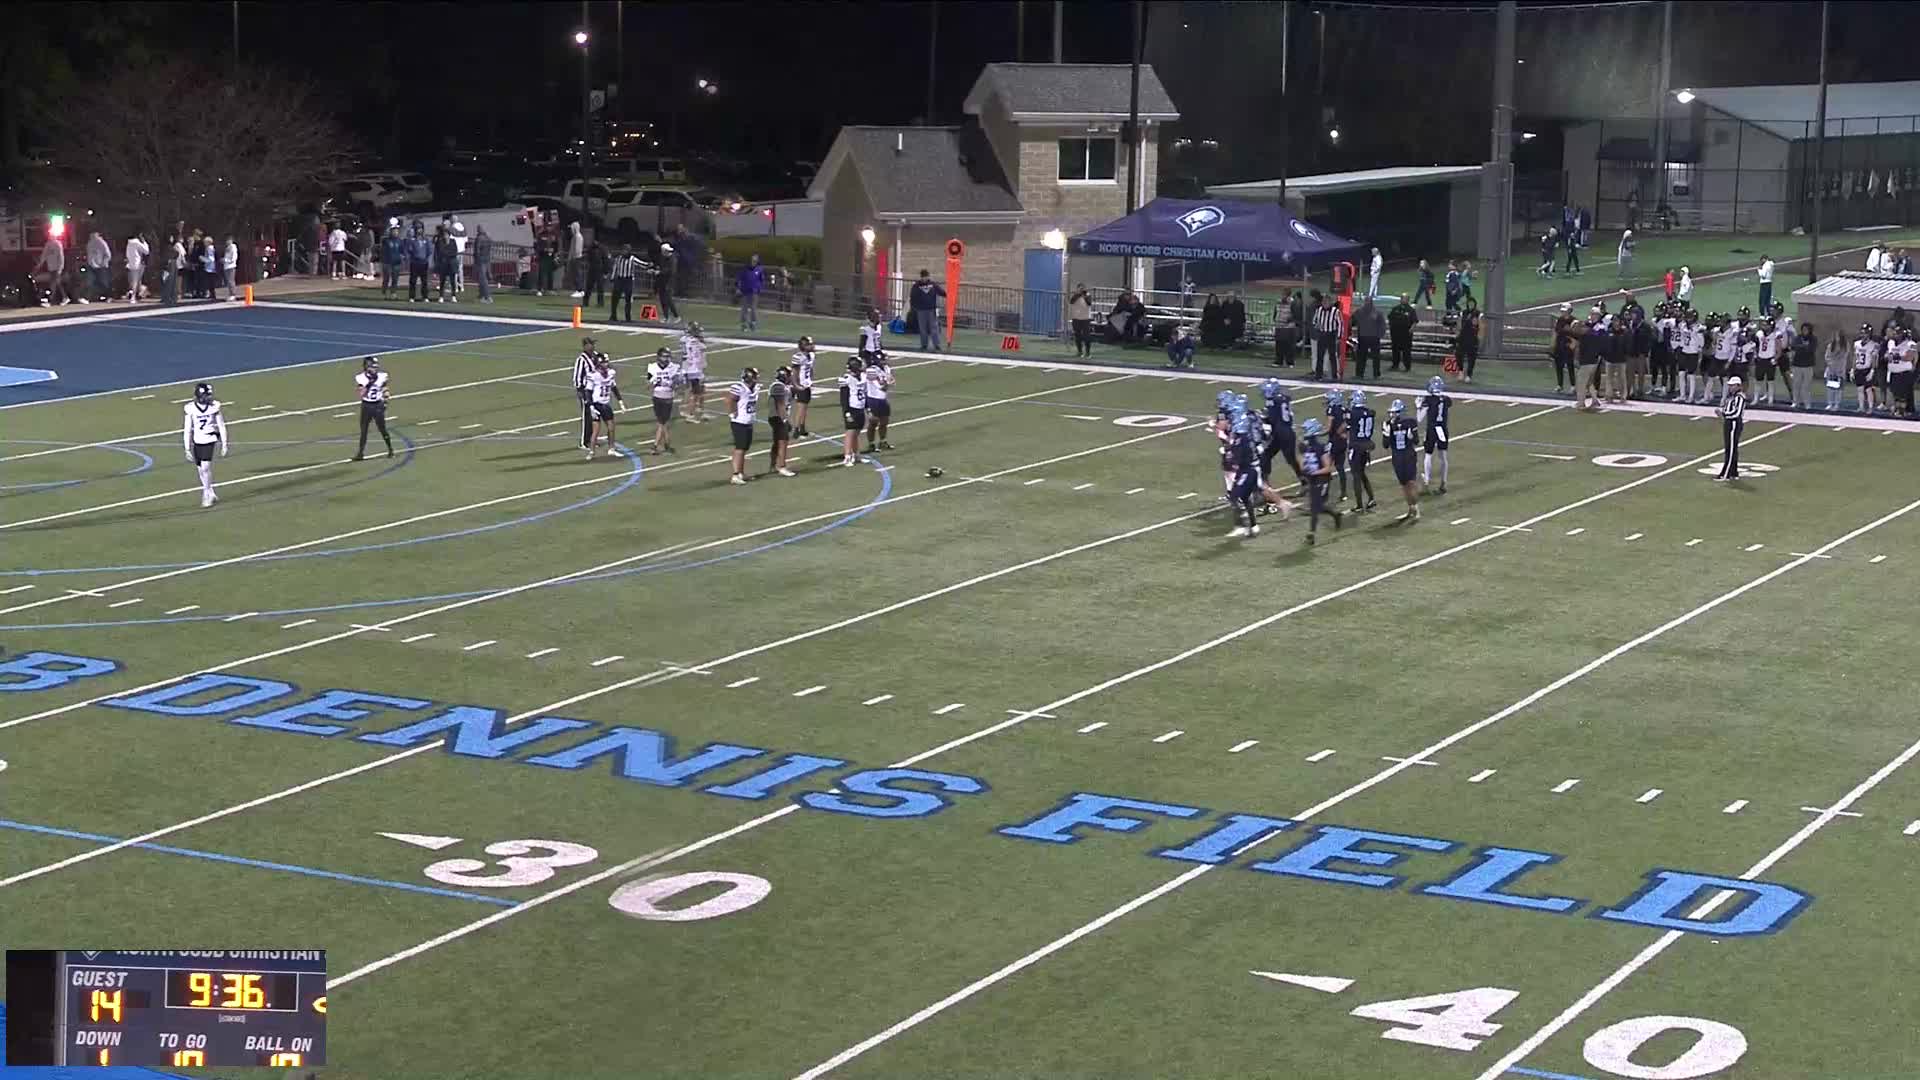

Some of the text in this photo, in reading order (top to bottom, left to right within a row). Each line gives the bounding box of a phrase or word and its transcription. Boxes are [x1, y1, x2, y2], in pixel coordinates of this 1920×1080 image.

[1099, 242, 1132, 254] NORTH
[1163, 246, 1215, 260] CHRISTIAN
[1217, 249, 1271, 263] FOOTBALL
[100, 671, 990, 818] DENNIS
[993, 792, 1814, 936] FIELD
